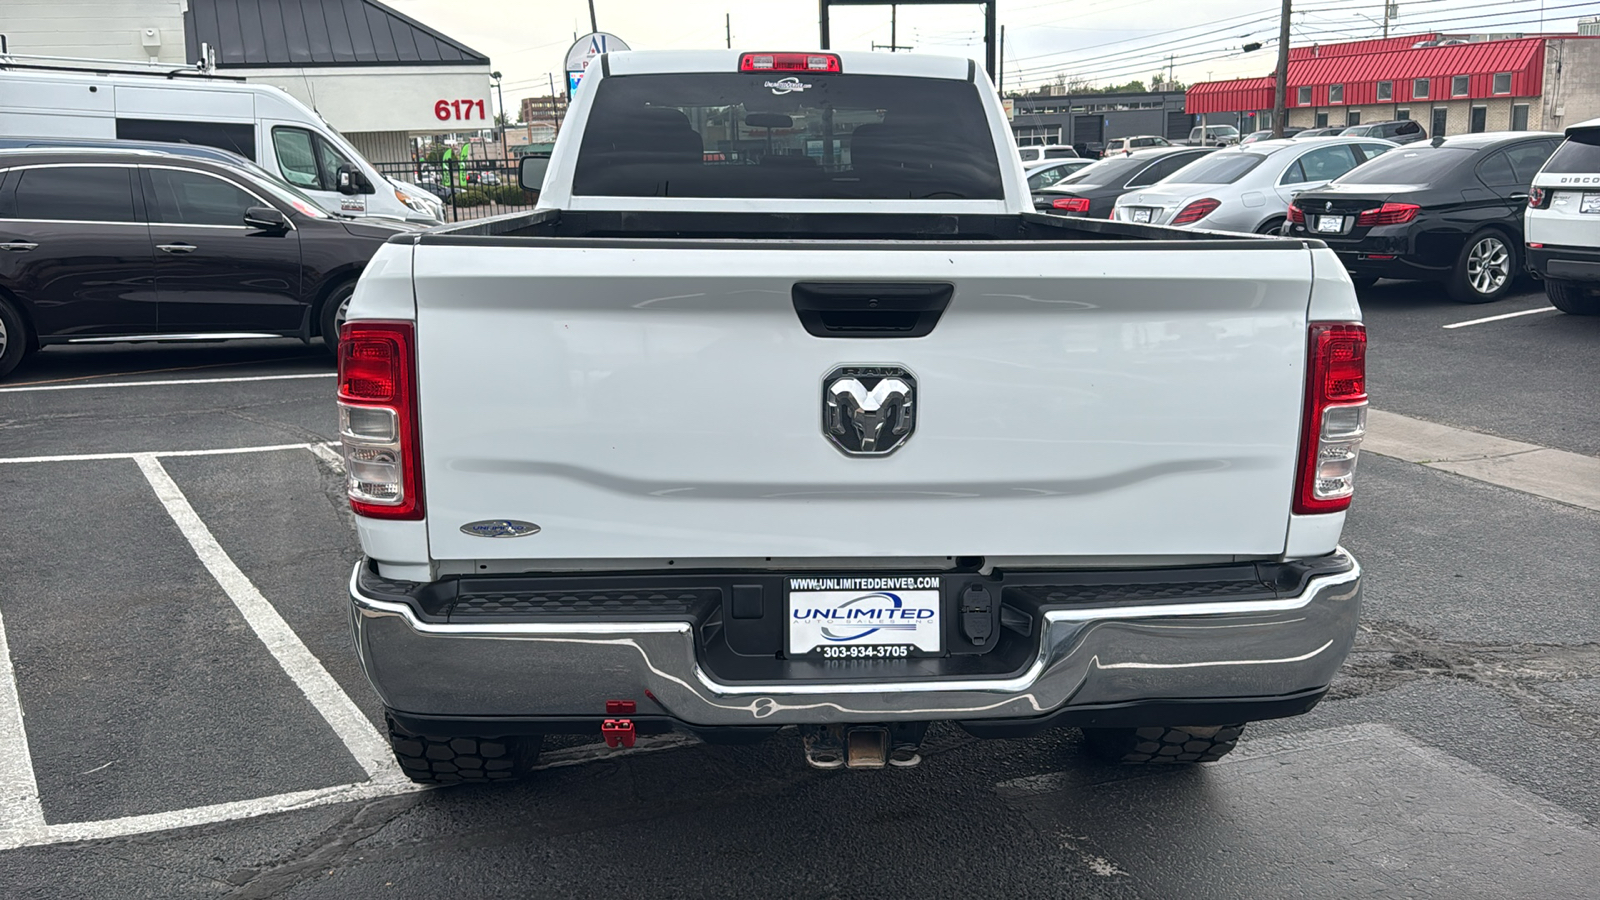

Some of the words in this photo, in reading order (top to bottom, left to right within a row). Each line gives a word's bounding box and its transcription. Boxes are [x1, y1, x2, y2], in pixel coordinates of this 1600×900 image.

[434, 99, 486, 121] 6171
[842, 367, 899, 377] RAM
[790, 577, 940, 590] WWW.UNLIMITEDDENVER.COM
[793, 608, 935, 620] UNLIMITED
[823, 645, 908, 658] 303-934-3705
